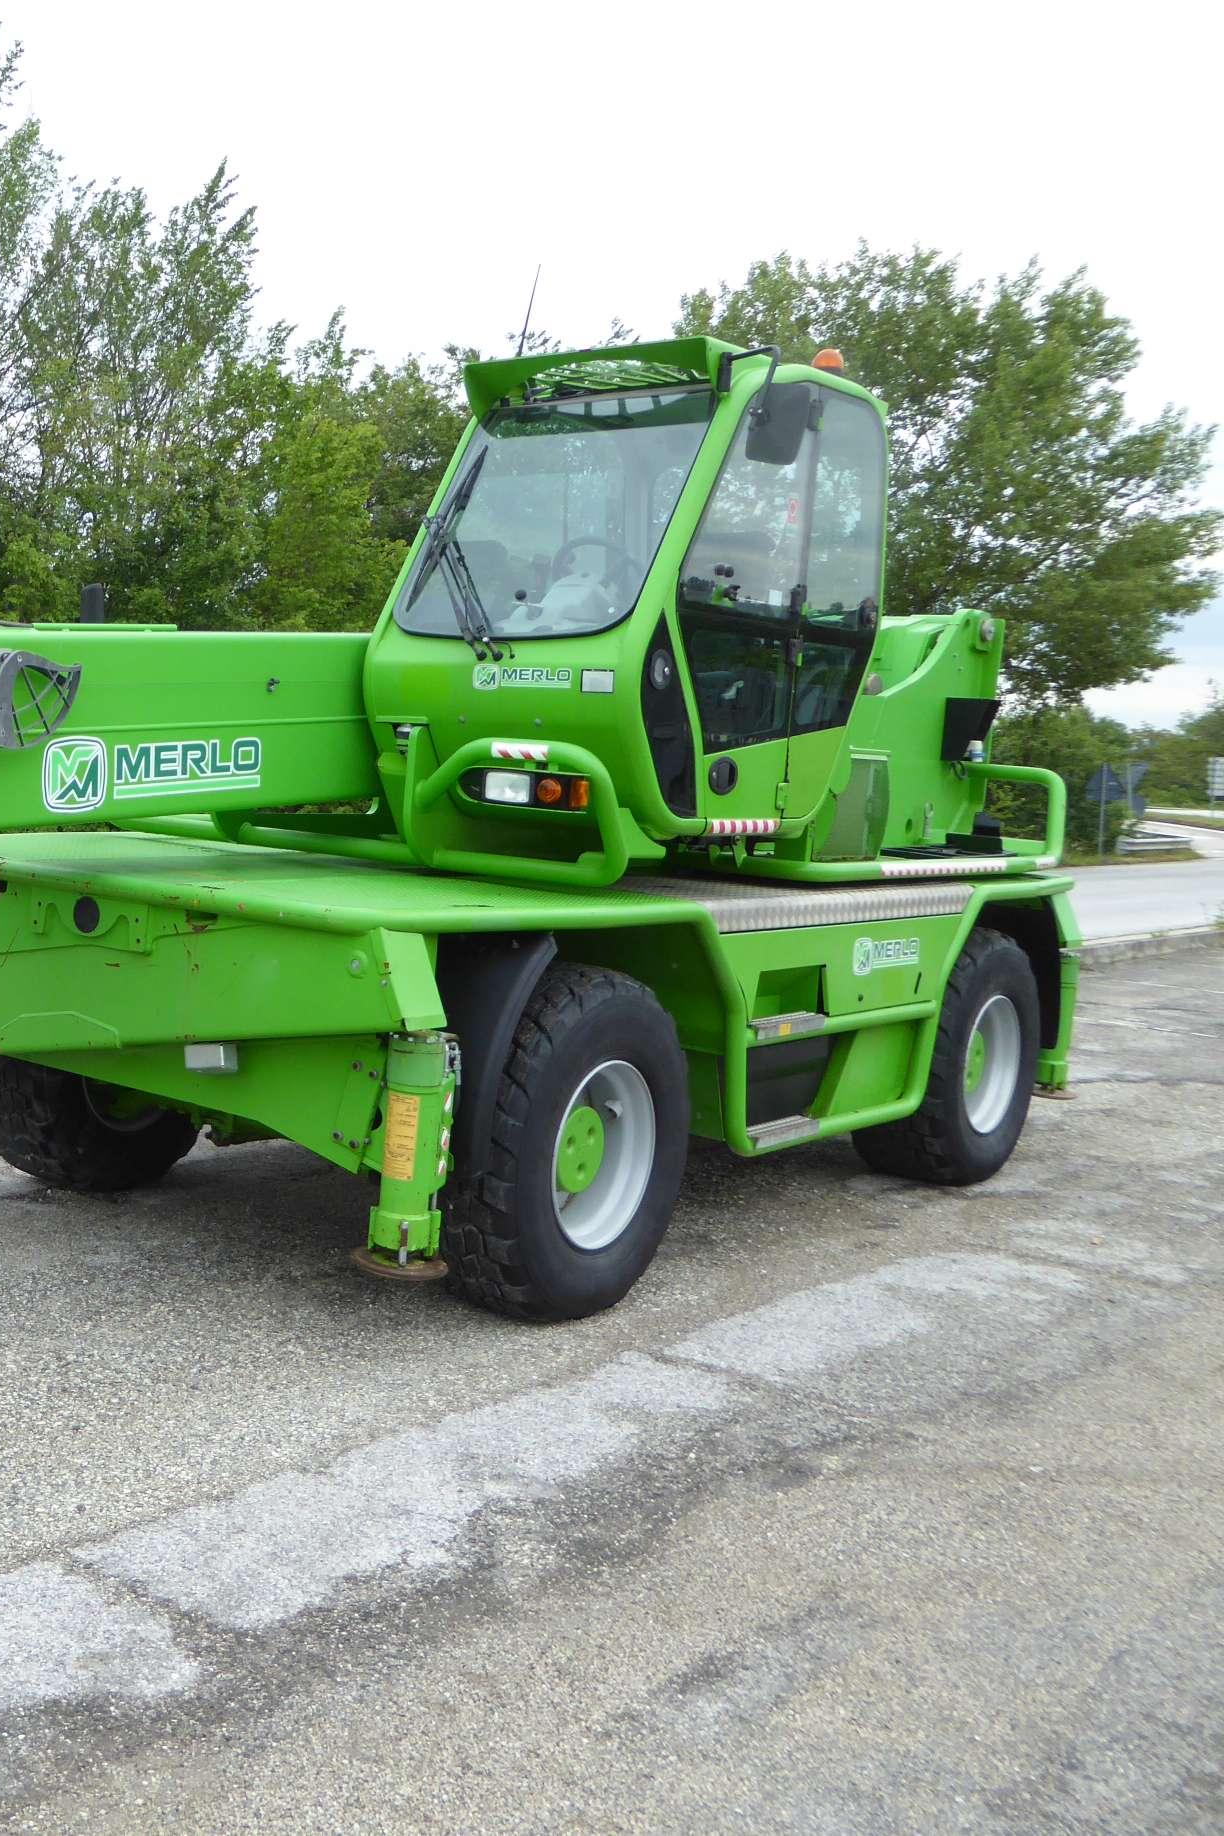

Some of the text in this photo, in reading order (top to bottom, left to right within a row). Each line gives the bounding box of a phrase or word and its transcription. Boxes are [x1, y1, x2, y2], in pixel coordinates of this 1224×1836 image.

[502, 668, 571, 682] MERLO
[115, 738, 260, 781] MERLO
[874, 939, 918, 958] MERLO
